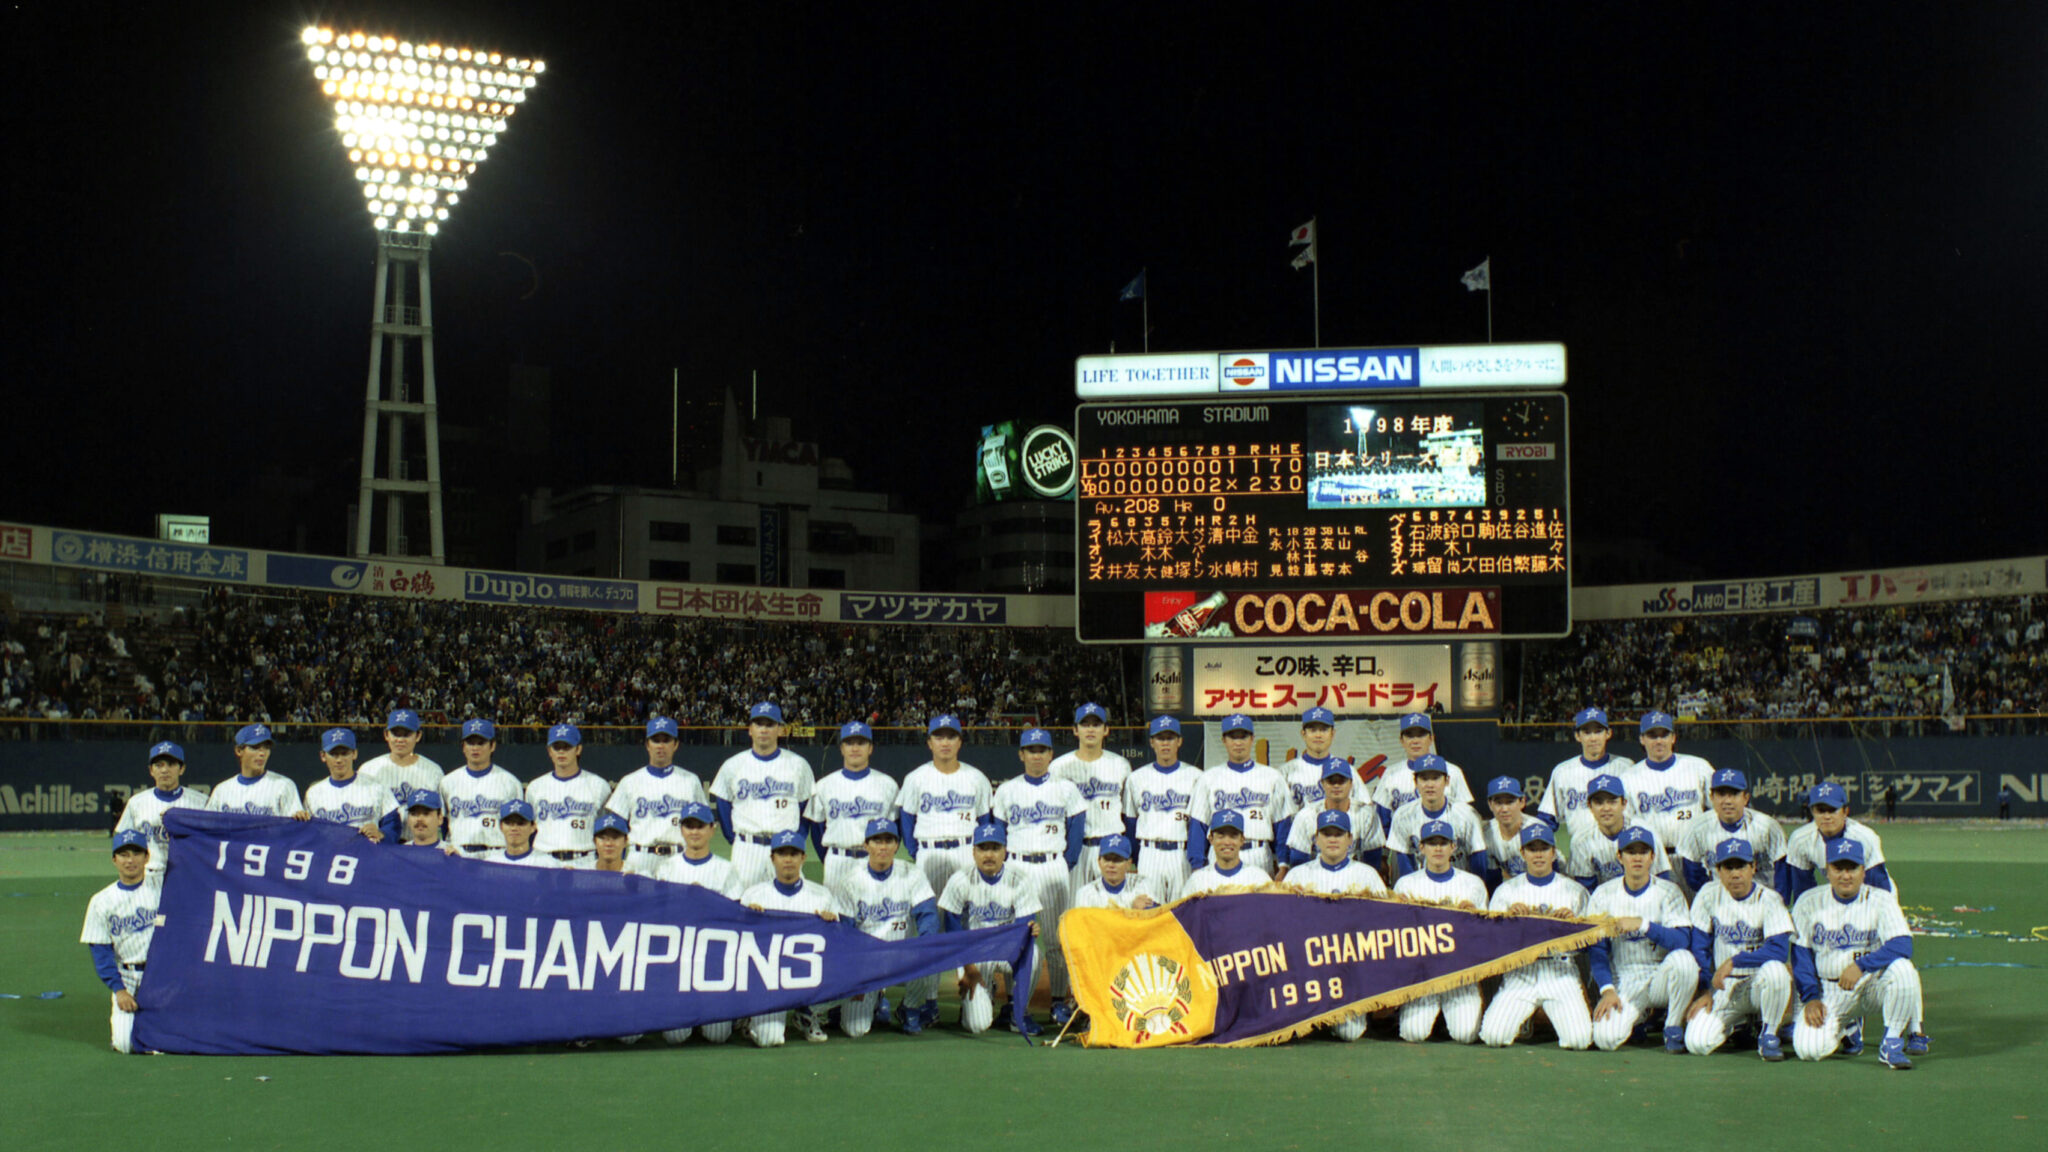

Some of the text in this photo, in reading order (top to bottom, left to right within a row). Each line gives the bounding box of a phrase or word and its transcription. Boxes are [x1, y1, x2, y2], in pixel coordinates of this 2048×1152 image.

[1083, 367, 1210, 383] LIFE TOGETHER
[1225, 368, 1264, 377] NISSAN
[1276, 355, 1412, 383] NISSAN
[1097, 406, 1269, 426] YOKOHAMA STADIUM
[1028, 440, 1061, 468] LUCKY
[1102, 444, 1299, 458] 1 2 3 4 5 6 7 8 9 R H E
[1505, 446, 1547, 458] RYOBI
[1034, 451, 1070, 480] STRIKE
[1082, 457, 1301, 479] L 0 0 0 0 0 0 0 0 1 1 7 0
[1099, 480, 1109, 494] 0
[1115, 480, 1125, 494] 0
[1131, 479, 1141, 494] 0
[1146, 479, 1157, 493] 0
[1162, 478, 1173, 493] 0
[1178, 478, 1189, 493] 0
[1194, 478, 1205, 493] 0
[1210, 477, 1220, 492] 2
[1250, 477, 1261, 492] 2
[1270, 476, 1281, 492] 3
[1290, 475, 1301, 491] 0
[1214, 497, 1225, 511] 0
[1430, 511, 1438, 521] 8
[1448, 511, 1456, 520] 7
[1465, 511, 1473, 520] 4
[1483, 510, 1491, 520] 3
[1500, 510, 1508, 520] 9
[1517, 510, 1525, 520] 2
[1535, 509, 1543, 520] 5
[1553, 510, 1558, 519] 1
[1111, 515, 1255, 527] 6 8 3 5 7 H R 2 H
[1269, 528, 1281, 536] PL
[1304, 527, 1316, 535] 2B
[1321, 527, 1333, 535] 3B
[1338, 527, 1350, 535] LL
[1355, 526, 1367, 534] RL
[85, 538, 244, 577] 横浜信用金庫
[1088, 520, 1102, 579] ライオンズ
[1107, 530, 1123, 578] 松井
[1125, 529, 1139, 578] 大友
[1157, 528, 1173, 578] 鈴木健
[1175, 529, 1190, 577] 大塚
[1209, 528, 1224, 577] 清水
[1225, 528, 1241, 576] 中嶋
[1242, 527, 1257, 576] 金村
[1270, 538, 1283, 576] 永見
[1304, 538, 1317, 576] 五十嵐
[1321, 537, 1334, 575] 友寄
[1339, 538, 1351, 574] 山本
[1356, 550, 1368, 562] 谷
[1427, 523, 1443, 573] 波留
[1444, 523, 1460, 573] 鈴木尚
[1462, 524, 1478, 572] ローズ
[1478, 522, 1495, 572] 駒田
[1496, 522, 1512, 572] 佐伯
[1514, 523, 1530, 572] 谷繁
[1531, 522, 1547, 572] 進藤
[1548, 522, 1565, 571] 佐々木
[389, 569, 435, 596] 白鶴
[467, 573, 552, 601] Duplo
[1726, 581, 1818, 608] 日総工産
[656, 586, 823, 617] 日本団体生命
[848, 595, 998, 621] マツザカヤ
[1151, 671, 1183, 684] Asahi
[1255, 655, 1384, 677] この味、辛口。
[1463, 670, 1495, 681] Asahi
[1204, 682, 1439, 709] アサヒ スーパードライ
[0, 784, 99, 814] Achilles
[775, 800, 788, 809] 10
[1637, 787, 1697, 812] BayStars
[570, 820, 586, 829] 63
[957, 812, 971, 822] 74
[1677, 810, 1693, 820] 23
[1045, 825, 1058, 834] 79
[216, 841, 358, 885] 1998
[891, 922, 907, 931] 73
[204, 890, 826, 993] NIPPON CHAMPIONS
[1197, 923, 1455, 989] NIPPON CHAMPIONS
[1270, 977, 1344, 1009] 1998
